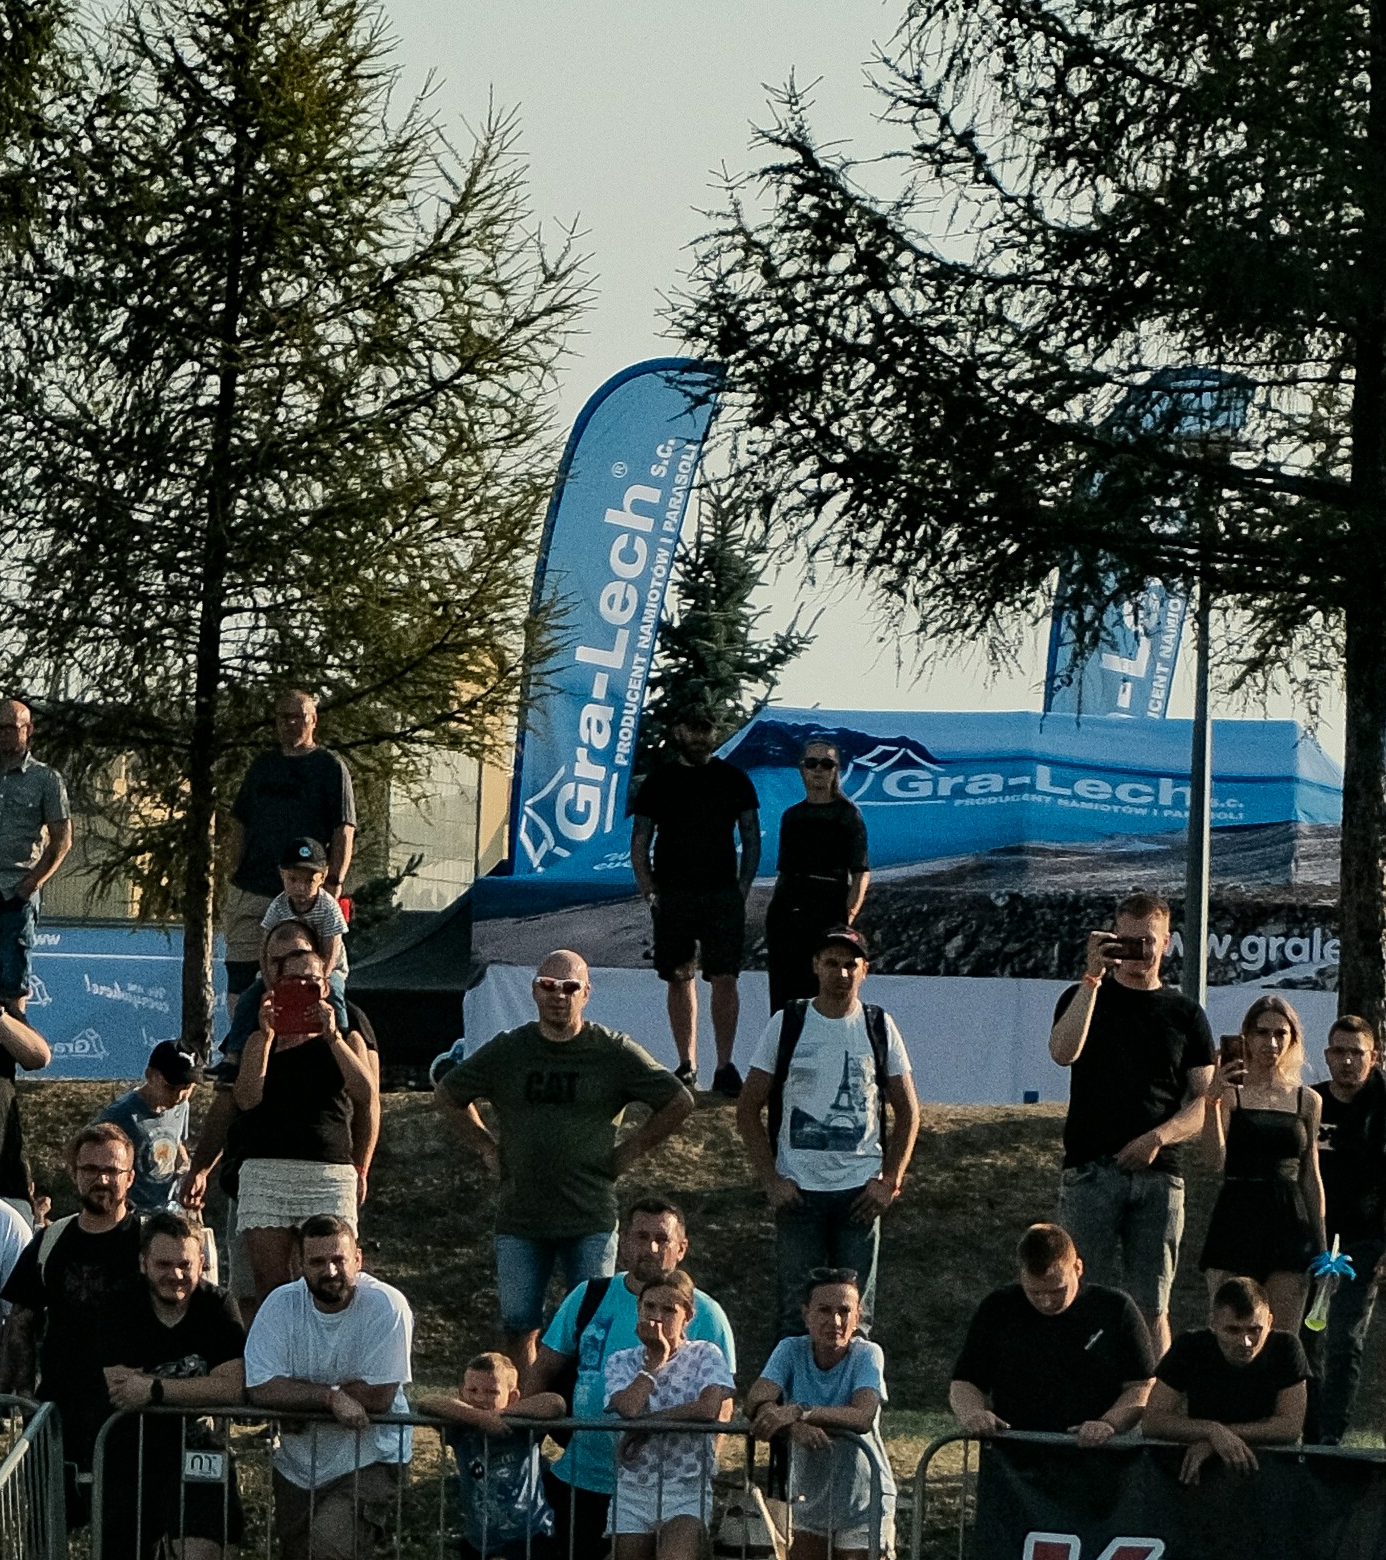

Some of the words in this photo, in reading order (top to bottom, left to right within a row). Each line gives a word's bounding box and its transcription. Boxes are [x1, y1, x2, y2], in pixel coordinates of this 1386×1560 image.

[663, 443, 699, 532] PARASOLI
[661, 536, 673, 545] I
[637, 548, 671, 649] NAMIOTÓW
[615, 653, 647, 766] PRODUCENT
[882, 764, 1192, 806] Gra-Lech
[954, 792, 1050, 807] PRODUCENT
[1057, 796, 1146, 817] NAMIOTÓW
[526, 1071, 580, 1104] CAT
